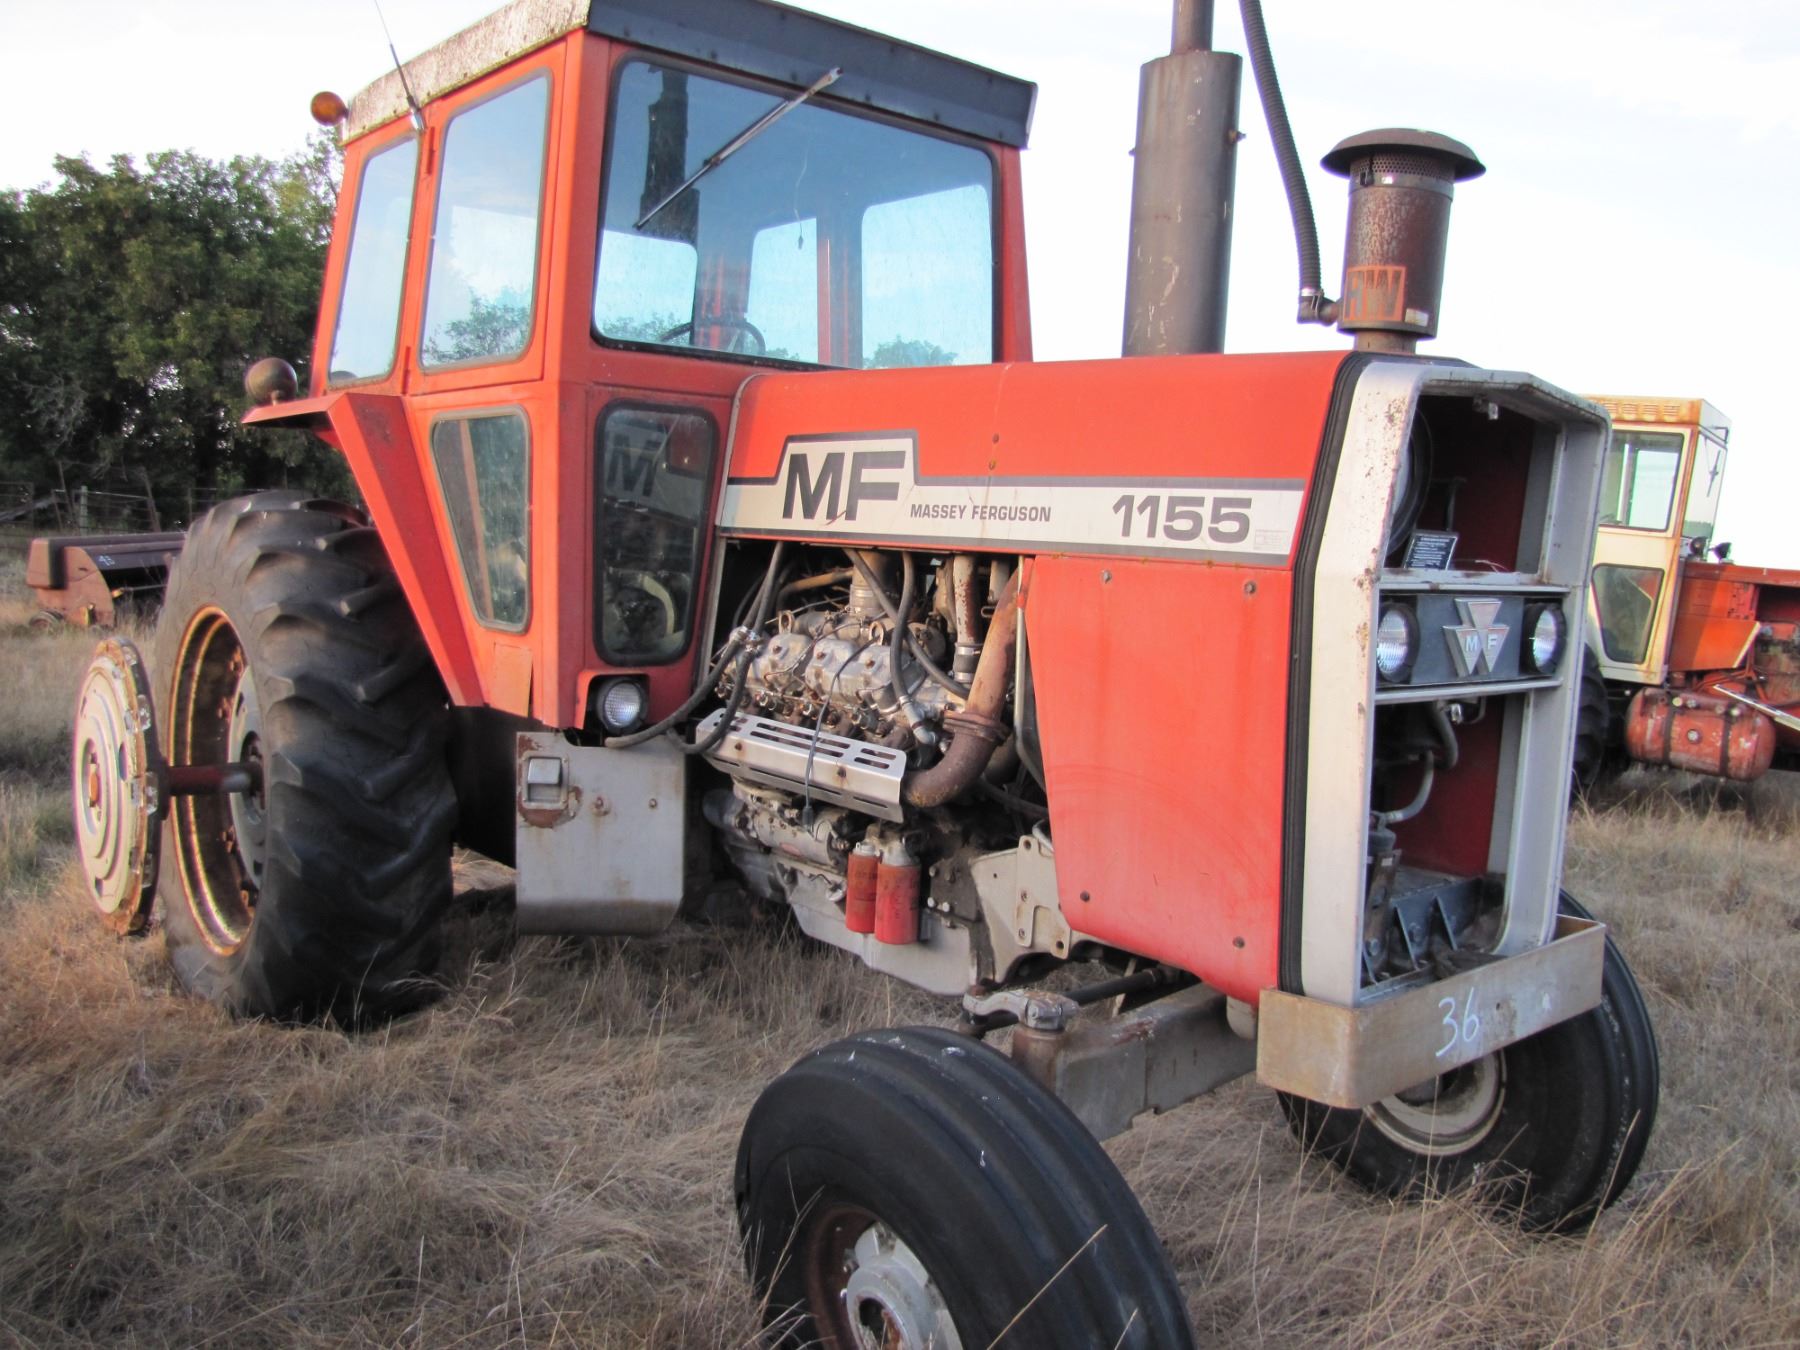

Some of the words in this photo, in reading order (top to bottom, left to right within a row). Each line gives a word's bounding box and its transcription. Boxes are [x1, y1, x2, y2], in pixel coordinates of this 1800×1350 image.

[782, 450, 906, 521] MF
[910, 503, 966, 520] MASSEY
[971, 504, 1051, 522] FERGUSON
[1112, 494, 1252, 544] 1155
[1435, 987, 1480, 1057] 36
